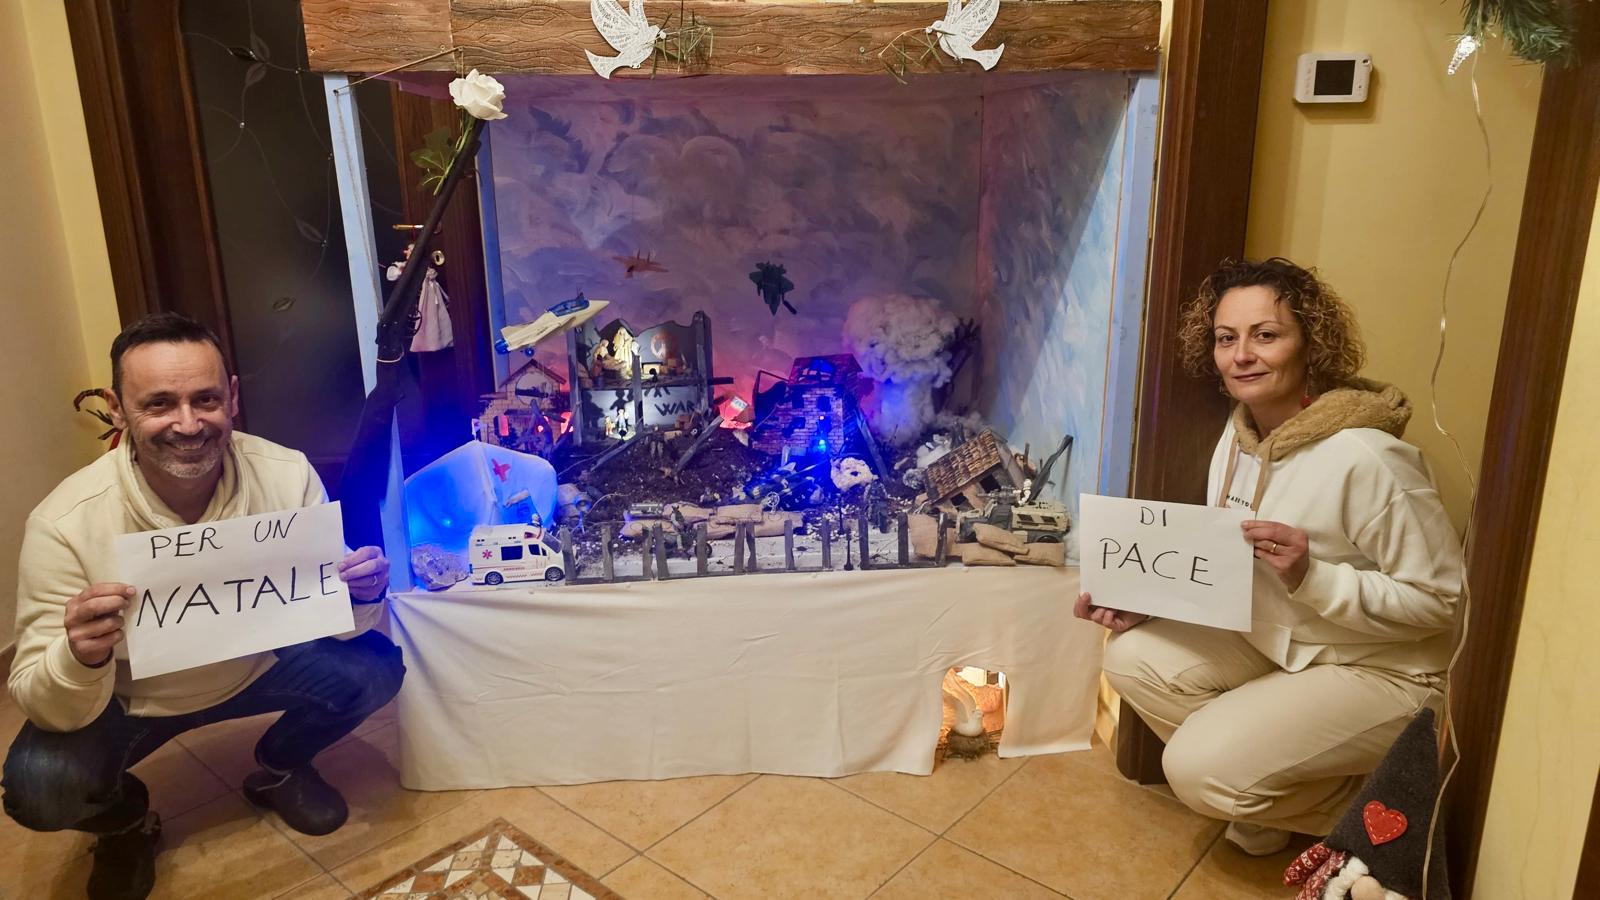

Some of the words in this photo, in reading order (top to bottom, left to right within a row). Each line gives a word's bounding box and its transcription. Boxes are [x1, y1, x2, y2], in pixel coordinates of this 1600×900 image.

[654, 400, 695, 417] WAR
[150, 526, 223, 559] PER
[254, 512, 298, 542] UN
[1140, 506, 1167, 527] DI
[1099, 537, 1214, 586] PACE
[136, 562, 338, 628] NATALE
